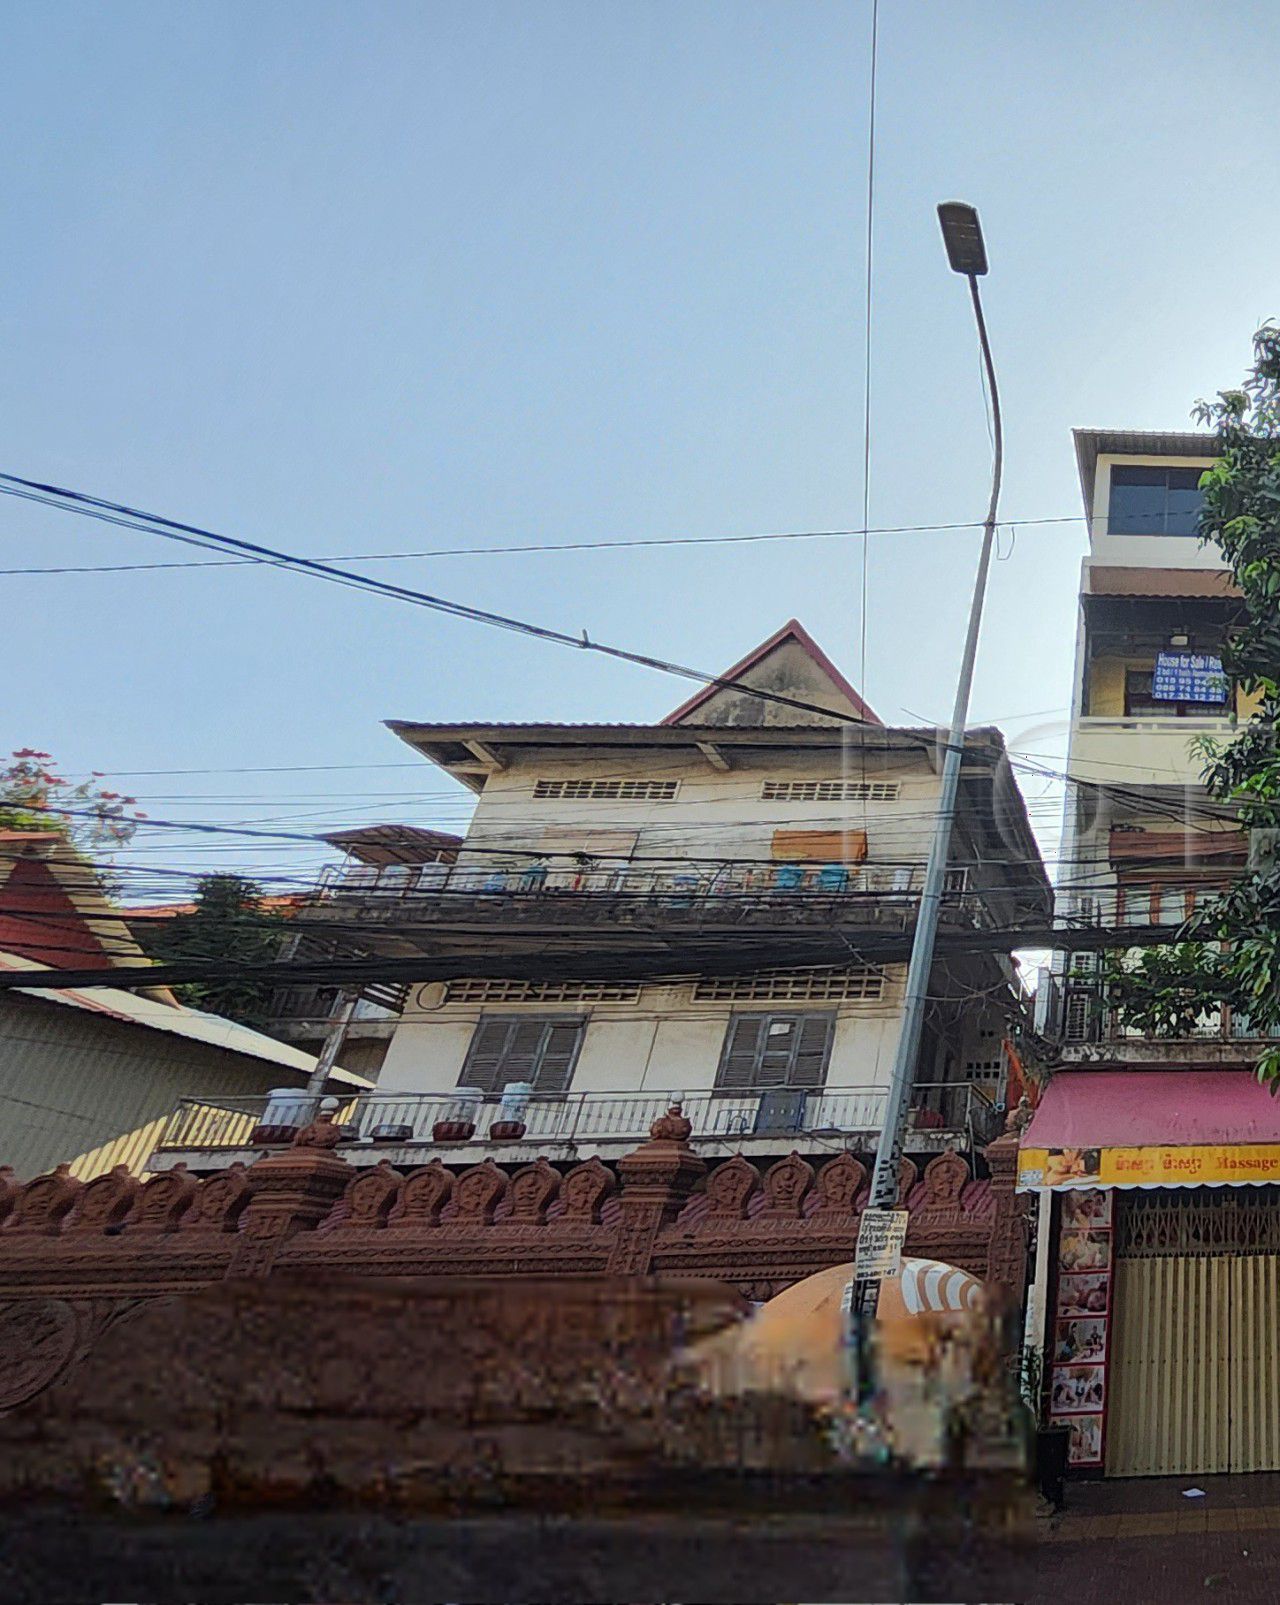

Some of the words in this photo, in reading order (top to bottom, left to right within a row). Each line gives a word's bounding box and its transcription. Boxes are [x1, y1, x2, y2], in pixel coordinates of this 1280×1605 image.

[1158, 652, 1179, 667] House
[1190, 654, 1204, 669] Sale
[1216, 1156, 1279, 1171] Massage
